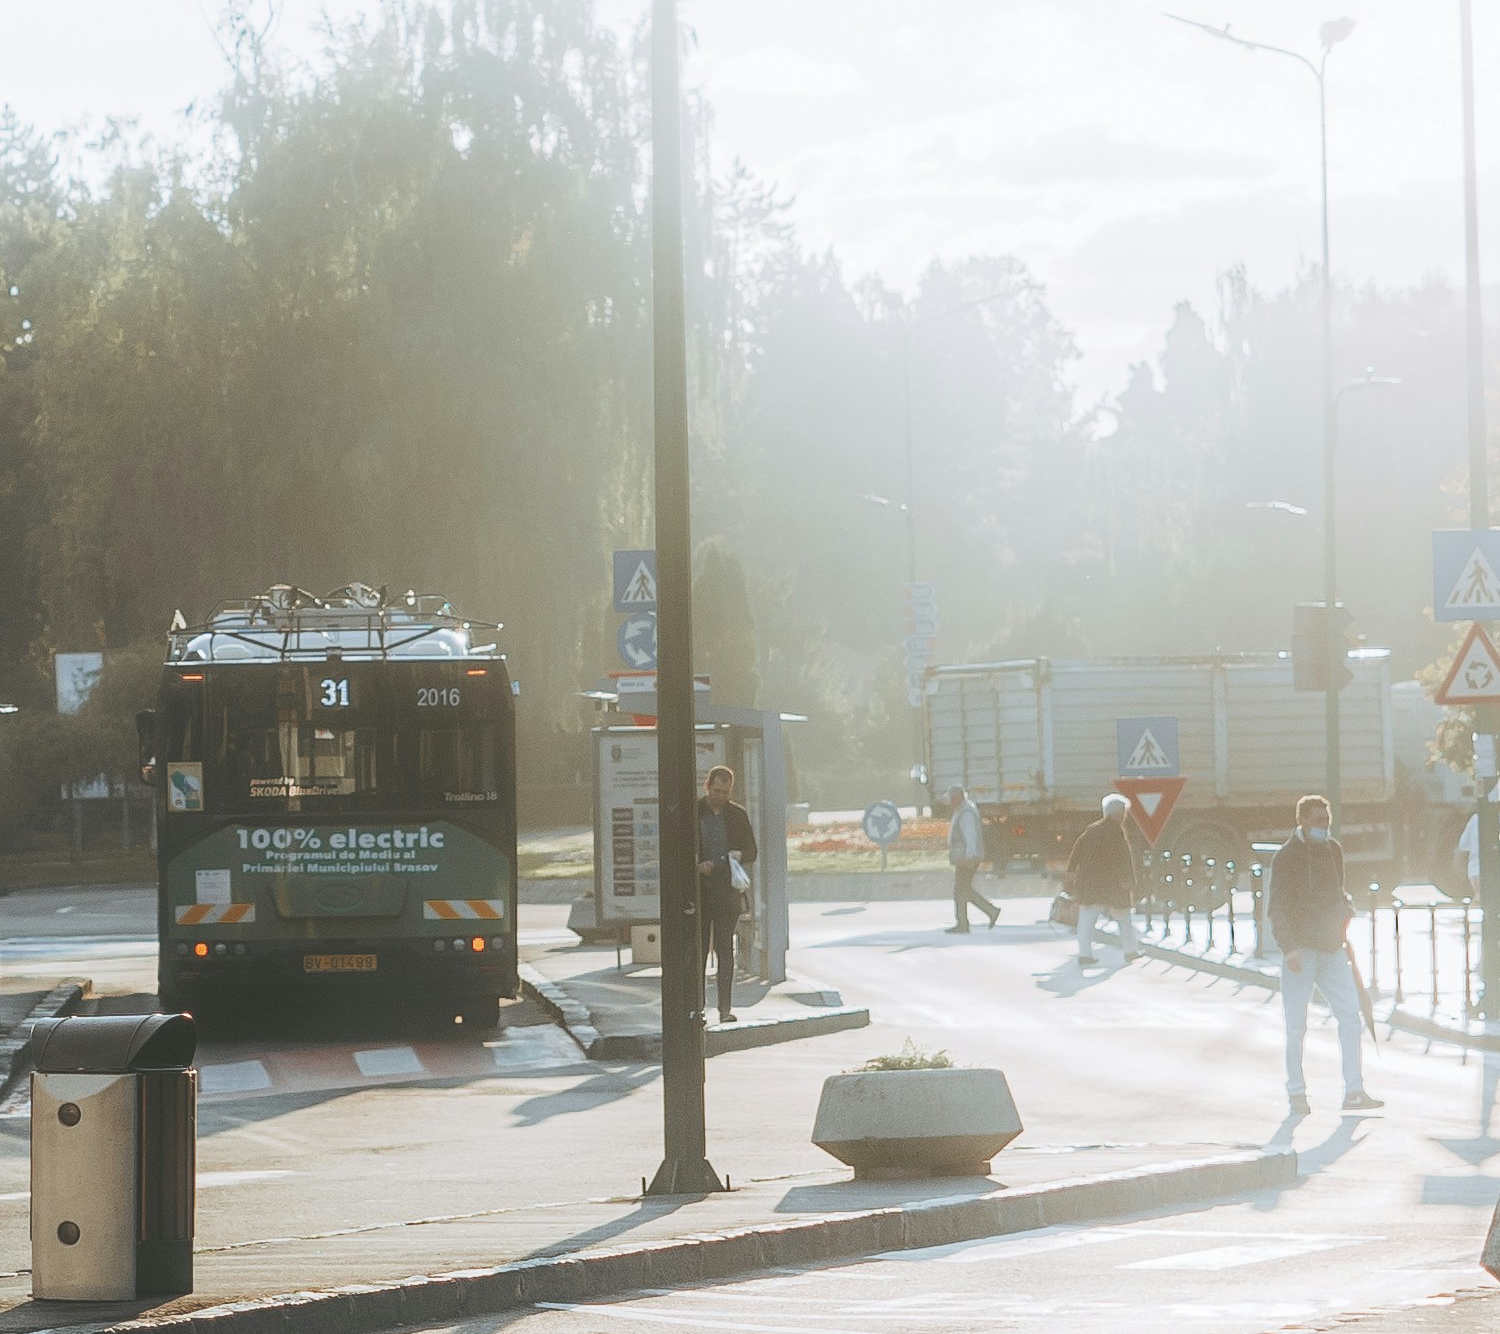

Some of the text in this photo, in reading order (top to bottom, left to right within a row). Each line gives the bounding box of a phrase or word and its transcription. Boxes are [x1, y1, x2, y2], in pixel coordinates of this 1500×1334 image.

[320, 678, 349, 707] 31
[417, 688, 460, 707] 2016
[444, 791, 485, 802] Trollino
[236, 827, 444, 850] 100% electric
[339, 851, 356, 860] de
[359, 851, 400, 860] Mediu
[403, 851, 416, 860] al
[307, 862, 390, 875] Municipiului
